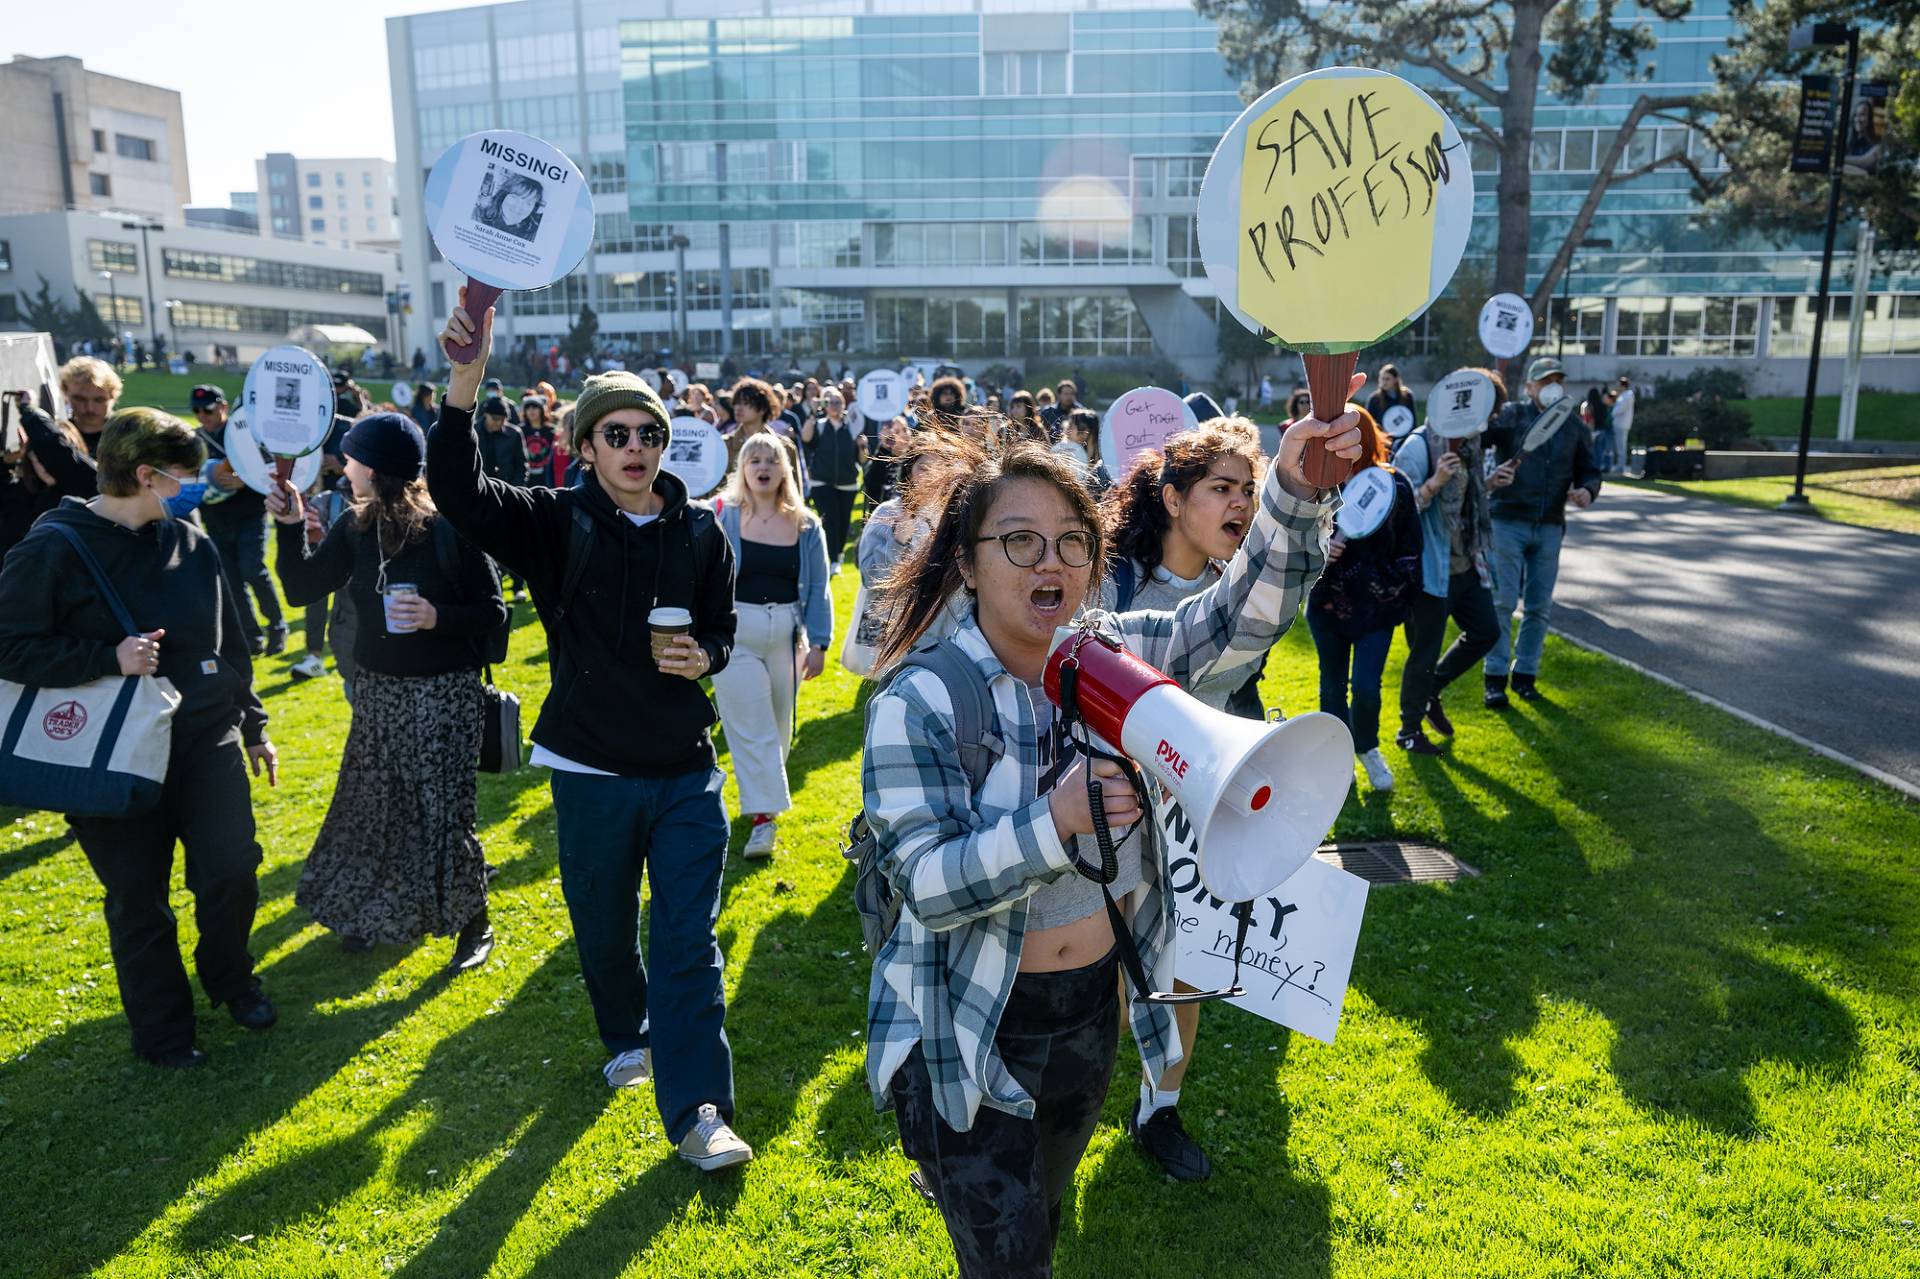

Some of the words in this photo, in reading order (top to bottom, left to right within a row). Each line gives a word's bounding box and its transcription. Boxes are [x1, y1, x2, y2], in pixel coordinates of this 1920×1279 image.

[1256, 91, 1401, 194] SAVE
[480, 138, 569, 184] MISSING!
[264, 360, 312, 375] MISSING!
[1125, 400, 1156, 416] Get
